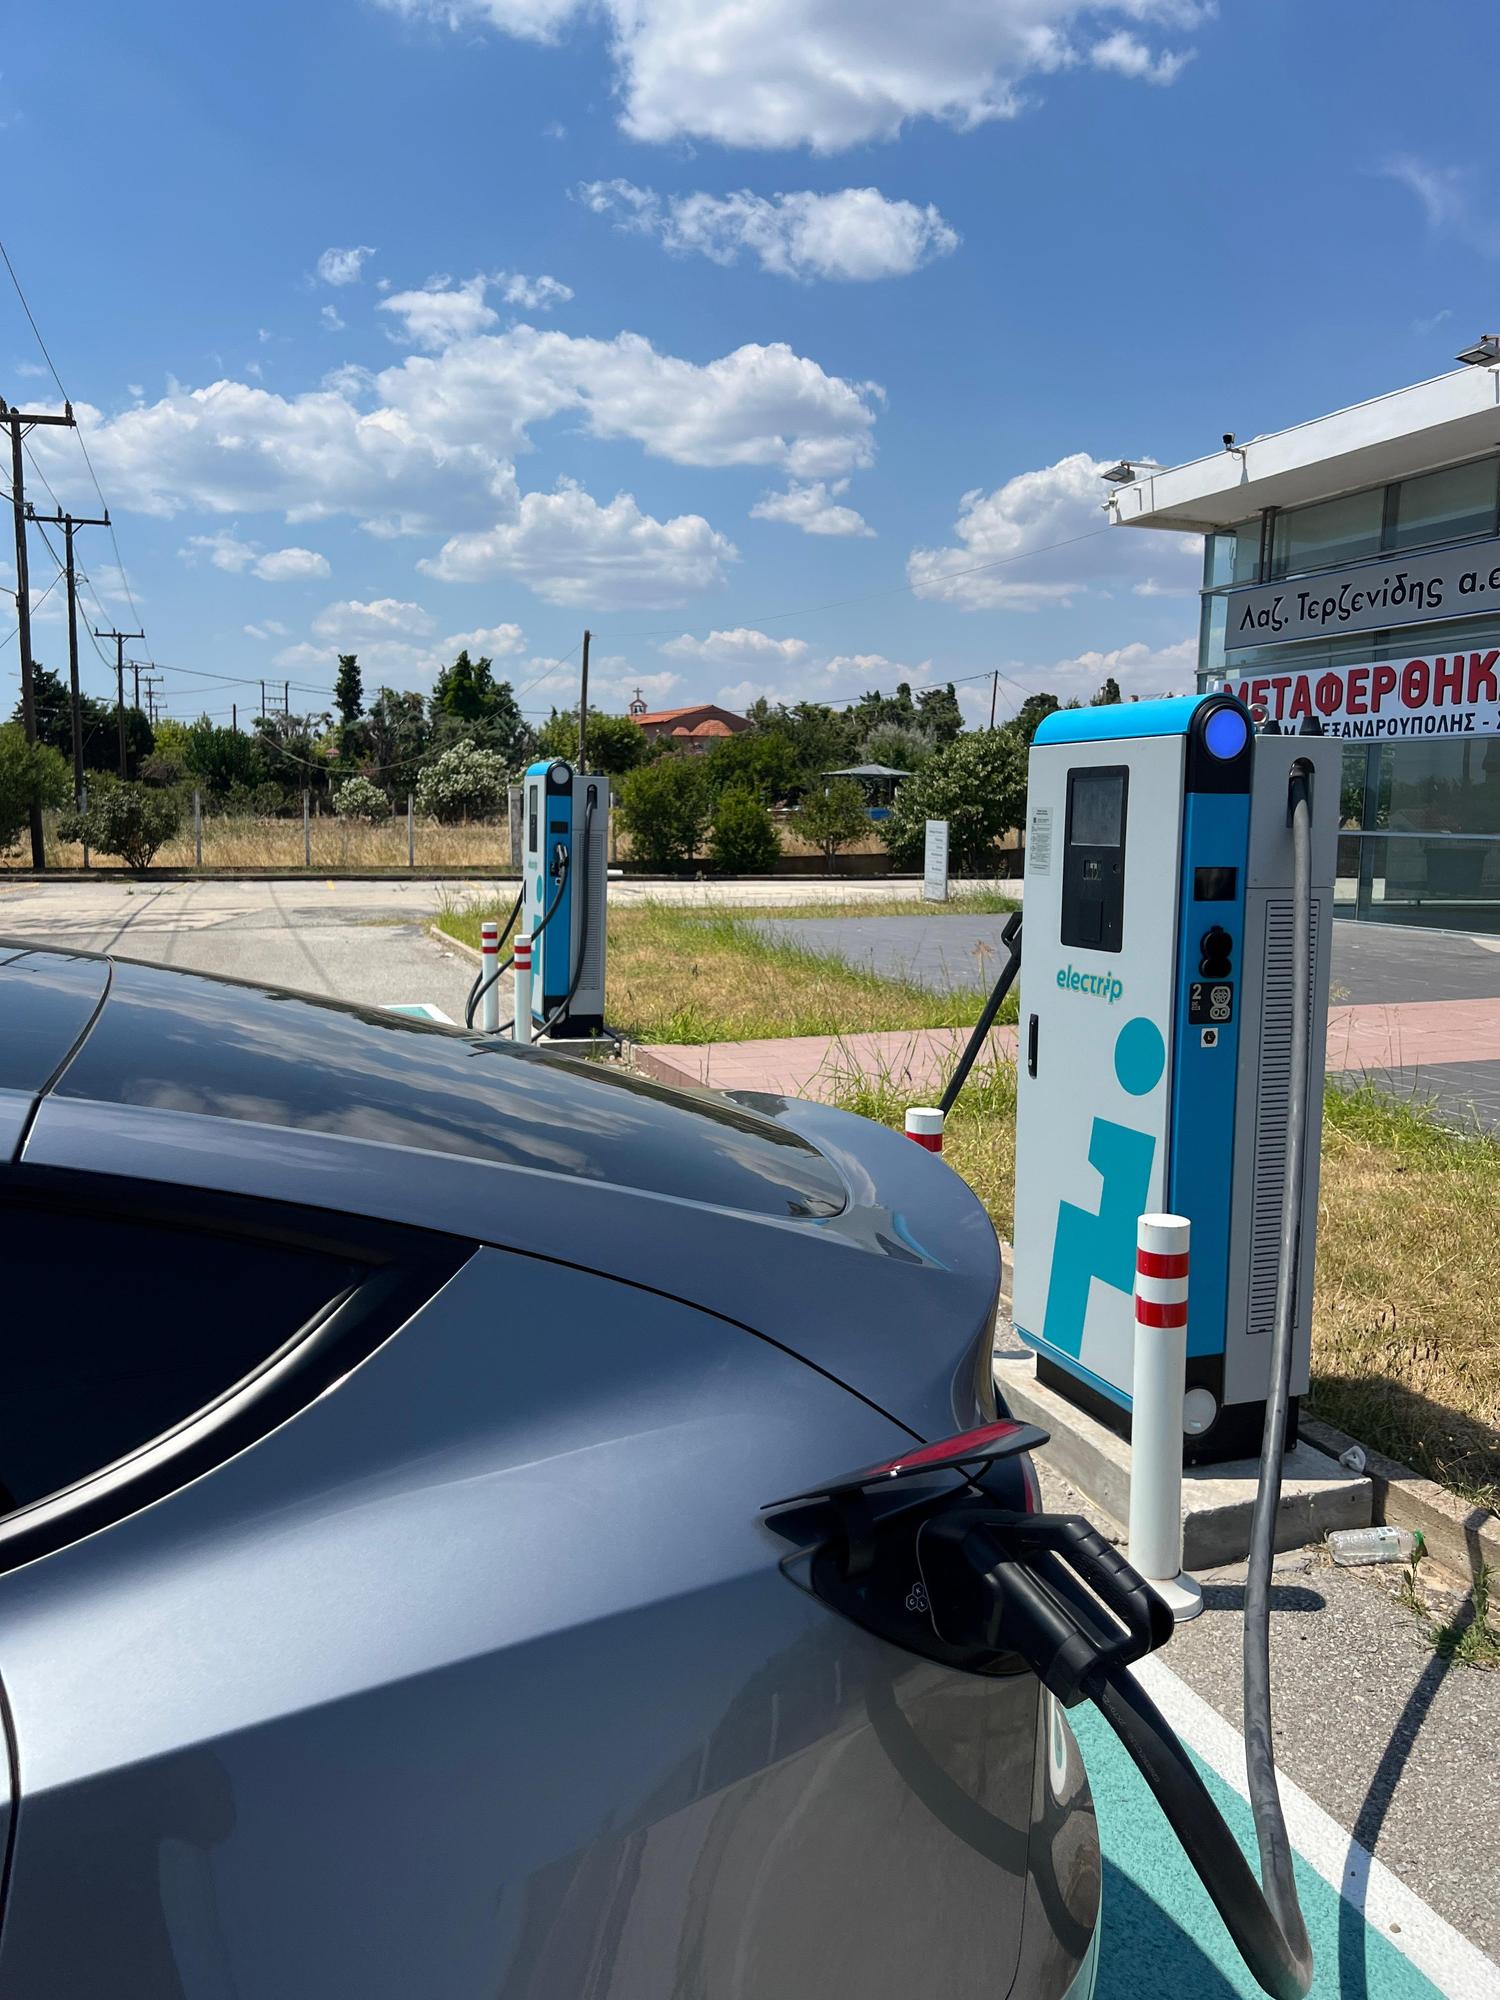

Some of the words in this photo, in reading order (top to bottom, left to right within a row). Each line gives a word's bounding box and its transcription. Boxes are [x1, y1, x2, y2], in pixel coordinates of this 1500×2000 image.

[1239, 597, 1289, 631] Λαζ.
[1297, 573, 1444, 624] Τερζενίδης
[1224, 650, 1500, 721] ΕΤΑΦΕΡΘΗΚ
[1321, 712, 1475, 738] ΕΞΑΝΔΡΟΥΠΟΛΗΣ
[1057, 964, 1122, 1003] electrip
[1192, 983, 1202, 1000] 2
